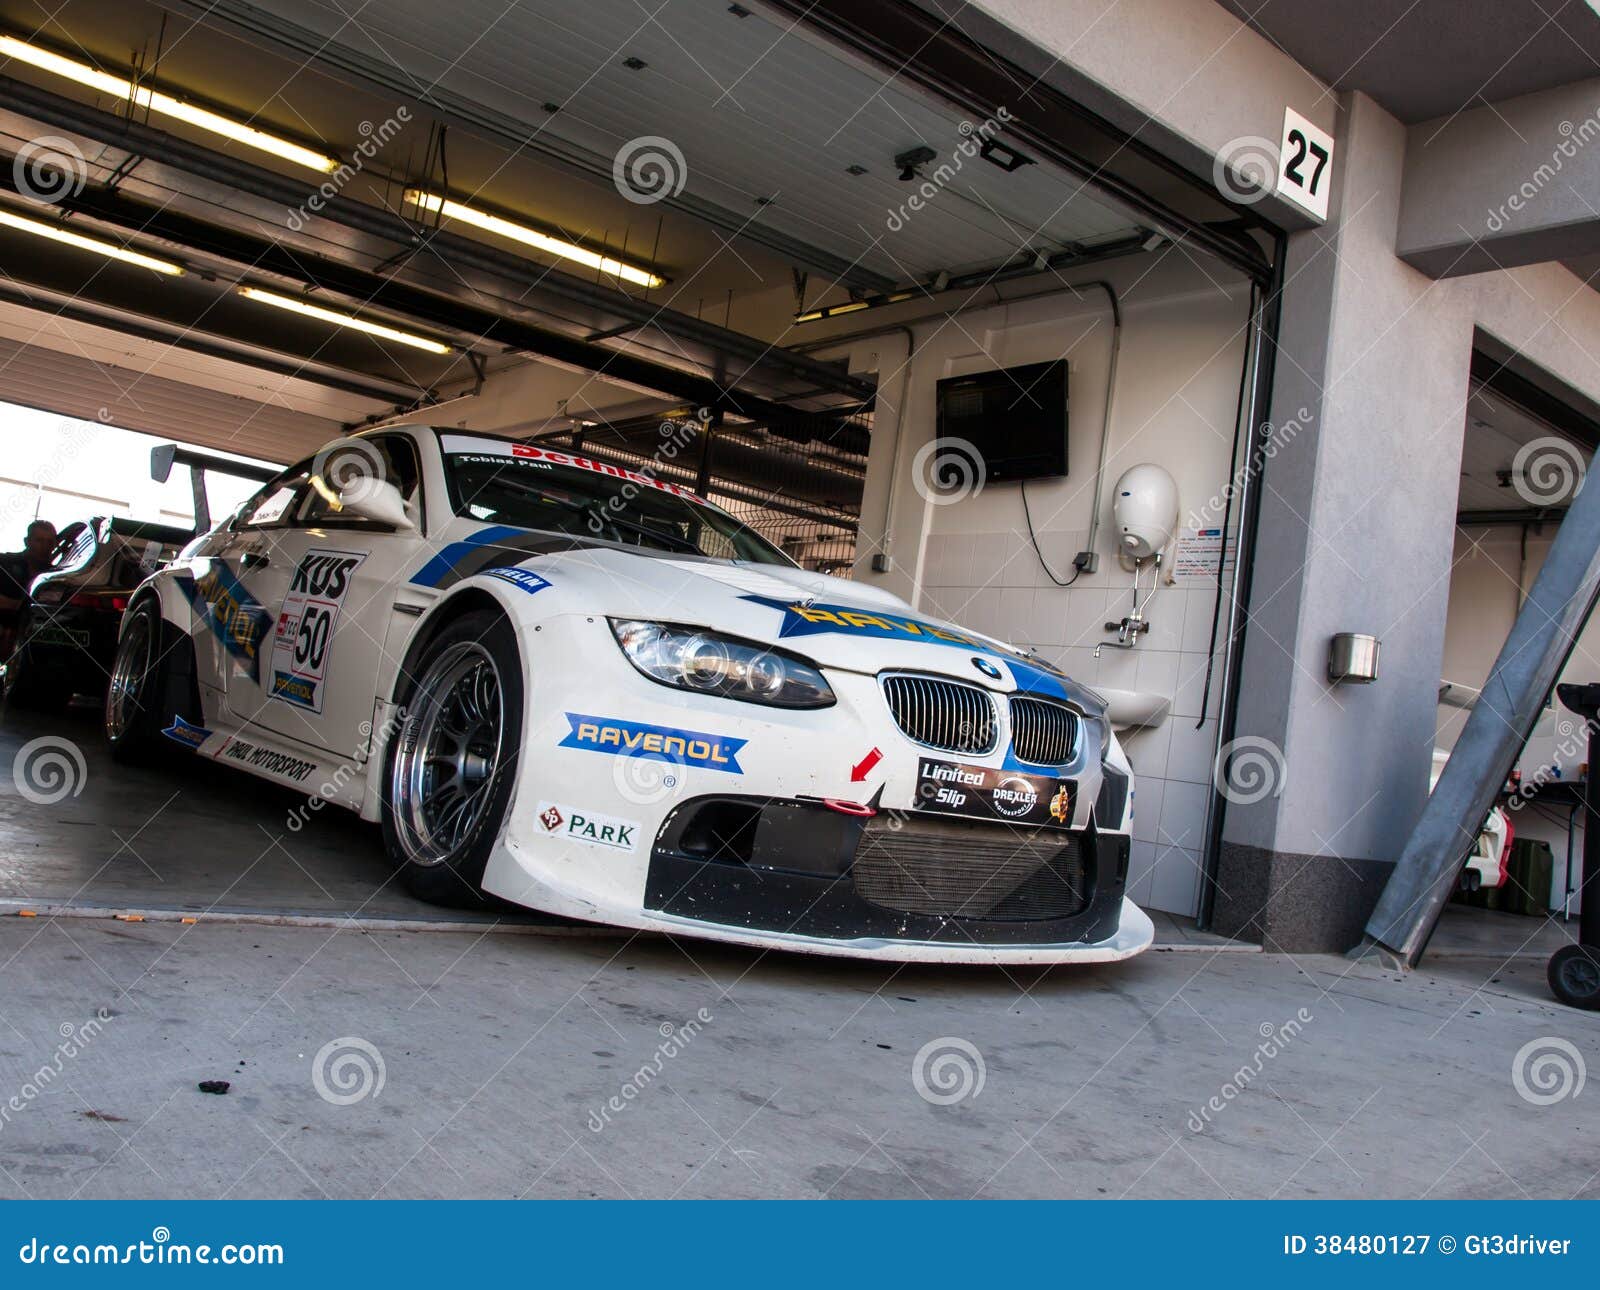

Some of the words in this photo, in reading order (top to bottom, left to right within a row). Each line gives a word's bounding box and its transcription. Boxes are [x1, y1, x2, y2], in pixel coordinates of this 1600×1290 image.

[1284, 129, 1329, 196] 27
[459, 455, 514, 465] Tobias
[518, 460, 553, 470] Paul
[295, 606, 331, 669] 50
[577, 723, 729, 763] RAVENOL
[250, 747, 317, 781] MOTORSPORT
[921, 763, 985, 786] Limited
[936, 788, 967, 808] Slip
[992, 788, 1039, 804] DREXLER
[568, 813, 635, 846] PARK
